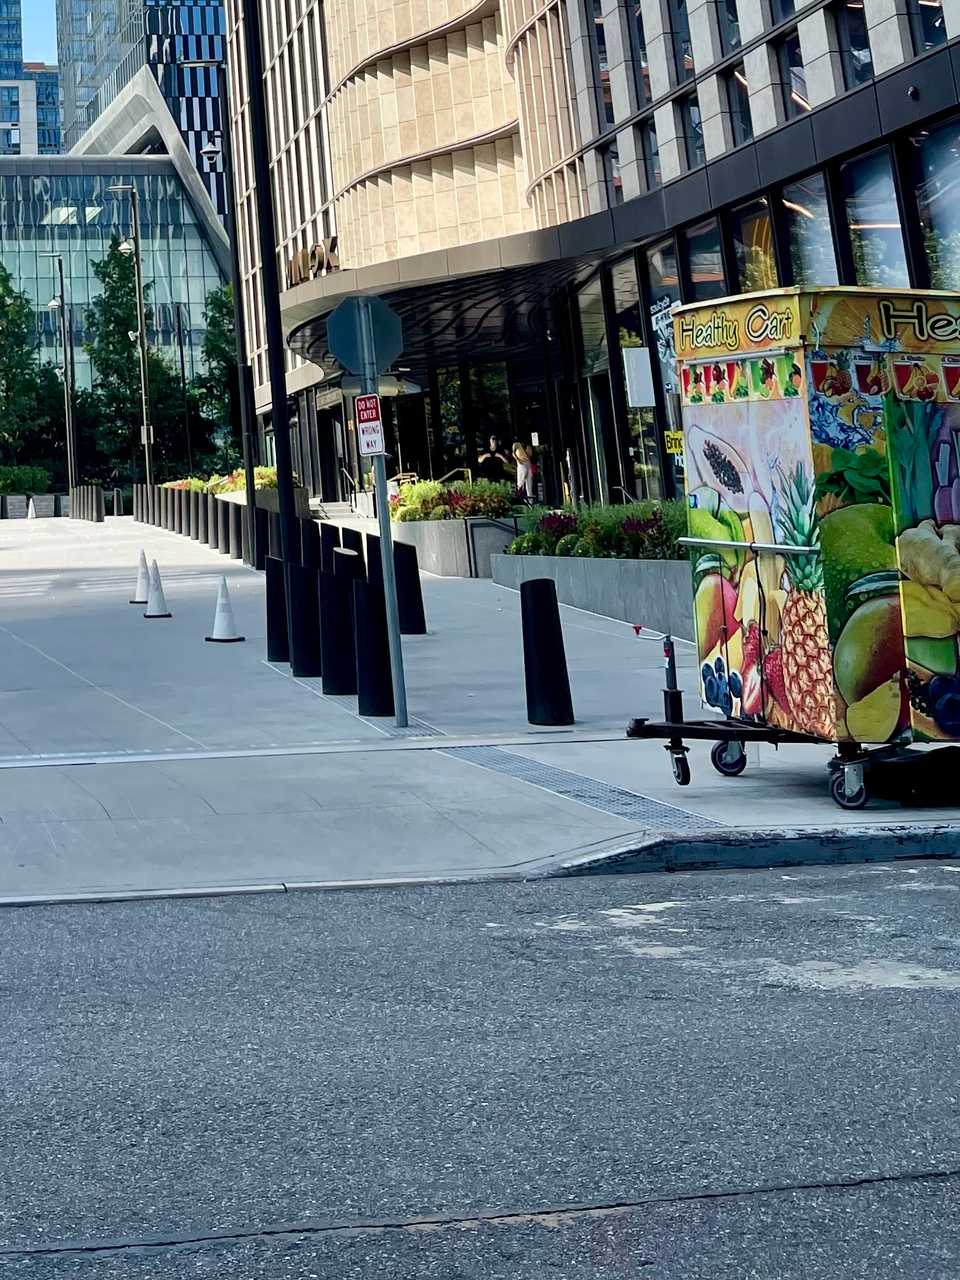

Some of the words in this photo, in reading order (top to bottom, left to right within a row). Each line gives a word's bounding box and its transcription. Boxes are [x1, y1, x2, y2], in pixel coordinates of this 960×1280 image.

[879, 300, 960, 341] He
[679, 312, 739, 351] Healthy
[745, 304, 793, 342] Cart
[358, 400, 365, 410] DO
[366, 399, 376, 409] NOT
[360, 410, 377, 420] ENTER
[361, 425, 380, 435] WRONG
[366, 440, 377, 449] WAY
